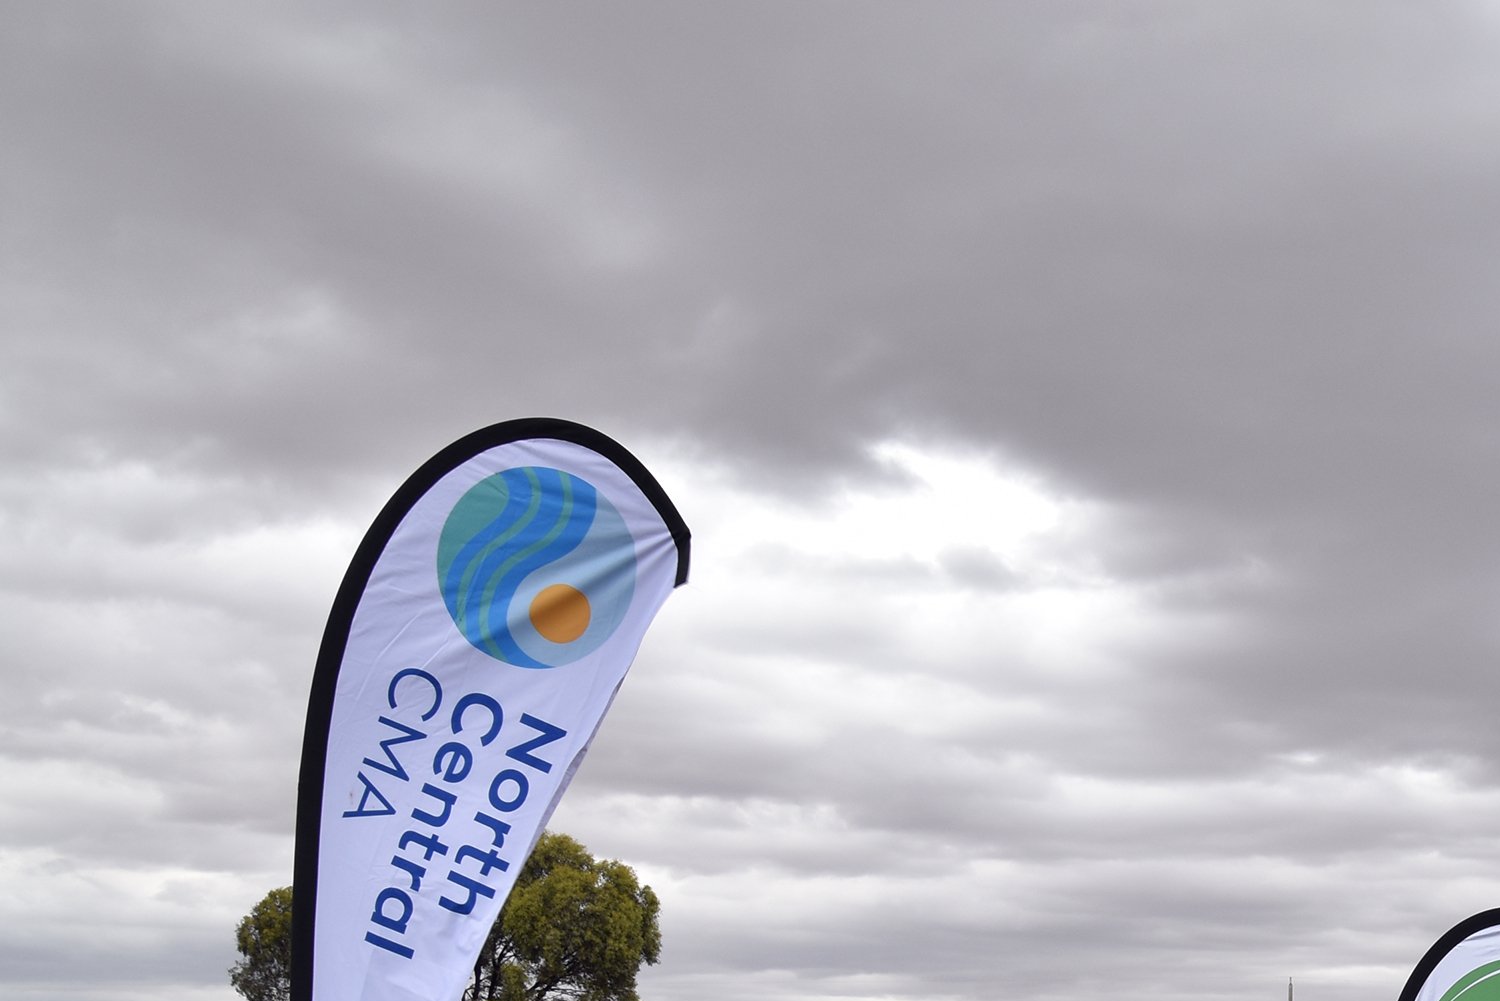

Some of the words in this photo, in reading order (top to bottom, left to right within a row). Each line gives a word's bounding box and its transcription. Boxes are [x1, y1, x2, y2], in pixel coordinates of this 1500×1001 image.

[342, 667, 443, 818] CMA
[364, 692, 504, 960] Central
[438, 712, 567, 915] North
